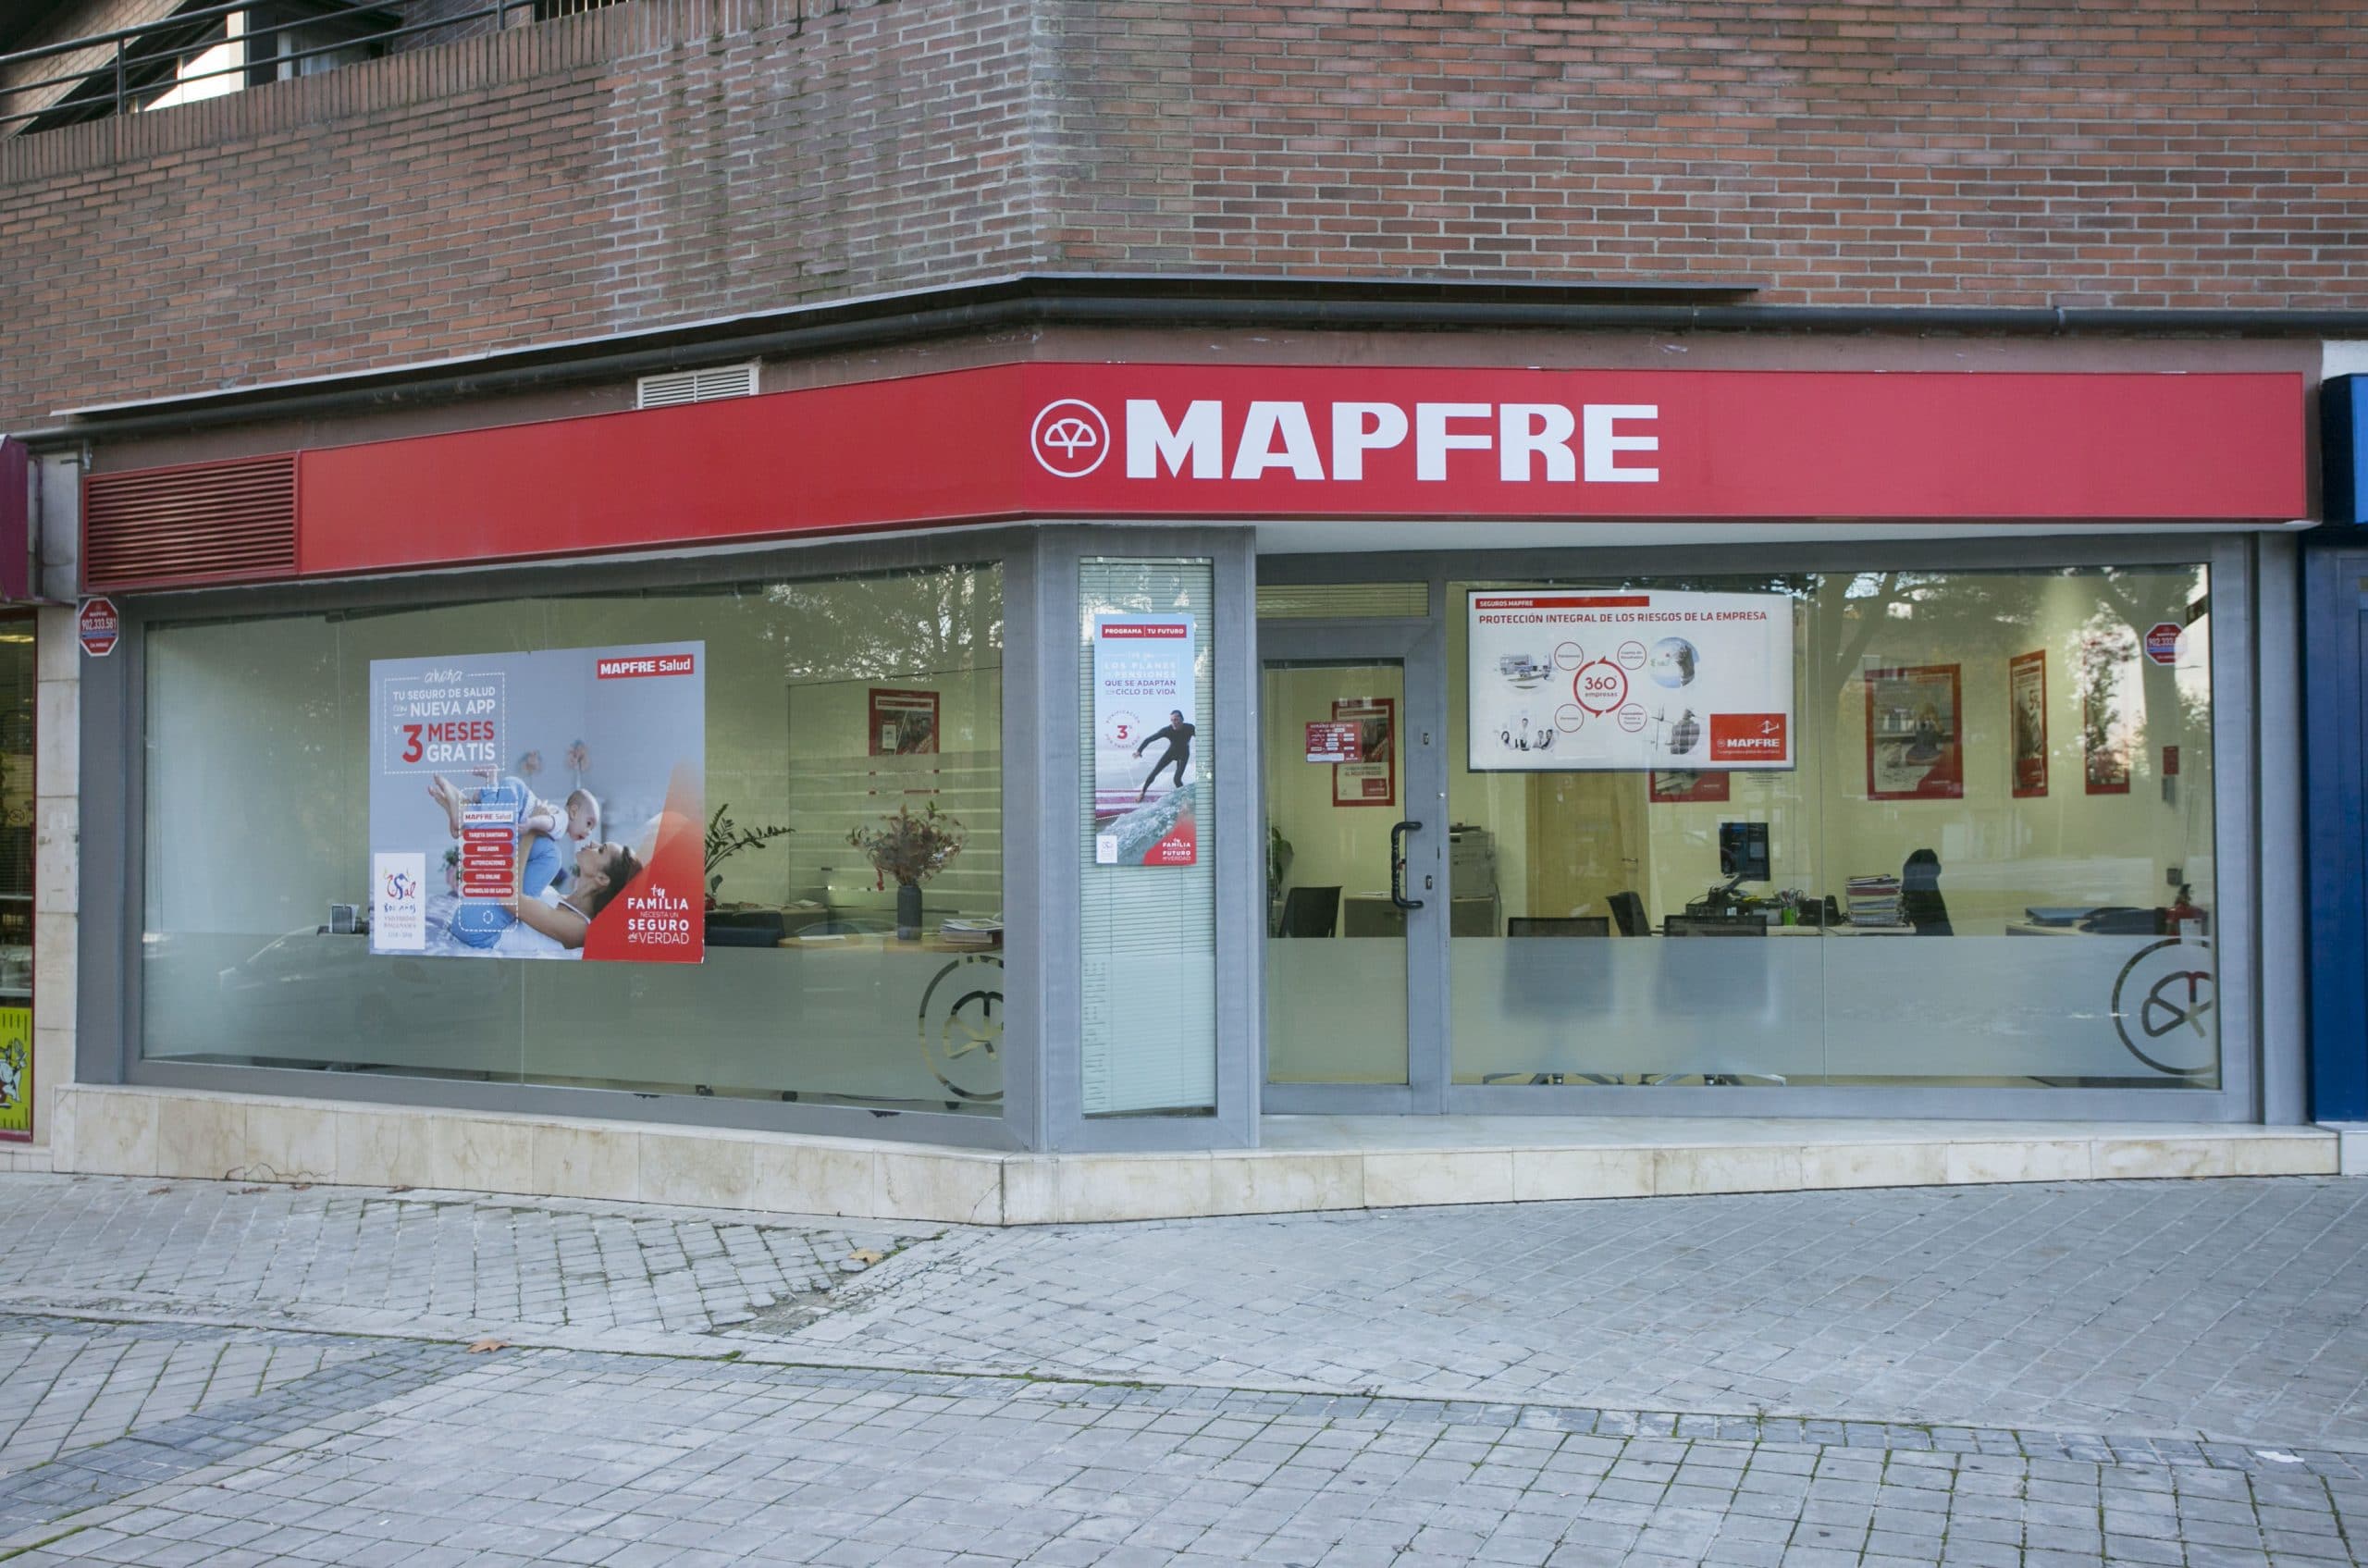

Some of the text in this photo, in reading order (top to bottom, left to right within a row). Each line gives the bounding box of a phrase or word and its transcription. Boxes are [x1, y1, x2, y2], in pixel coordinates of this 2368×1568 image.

[1126, 399, 1659, 483] MAPFRE
[1479, 611, 1767, 623] PROTECCIÓN INTEGRAL DE LOS RIESGOS DE LA EMPRESA
[600, 658, 691, 675] MAPFRE Salud
[393, 686, 496, 701] TU SEGURO DE SALUD
[410, 700, 462, 718] NUEVA
[465, 698, 496, 715] APP
[393, 724, 400, 735] Y
[401, 720, 495, 763] 3 MESES
[1727, 738, 1781, 747] MAPFRE
[426, 742, 496, 762] GRATIS
[650, 883, 666, 899] tu
[627, 897, 688, 910] FAMILIA
[628, 919, 690, 932] SEGURO
[638, 932, 690, 945] VERDAD
